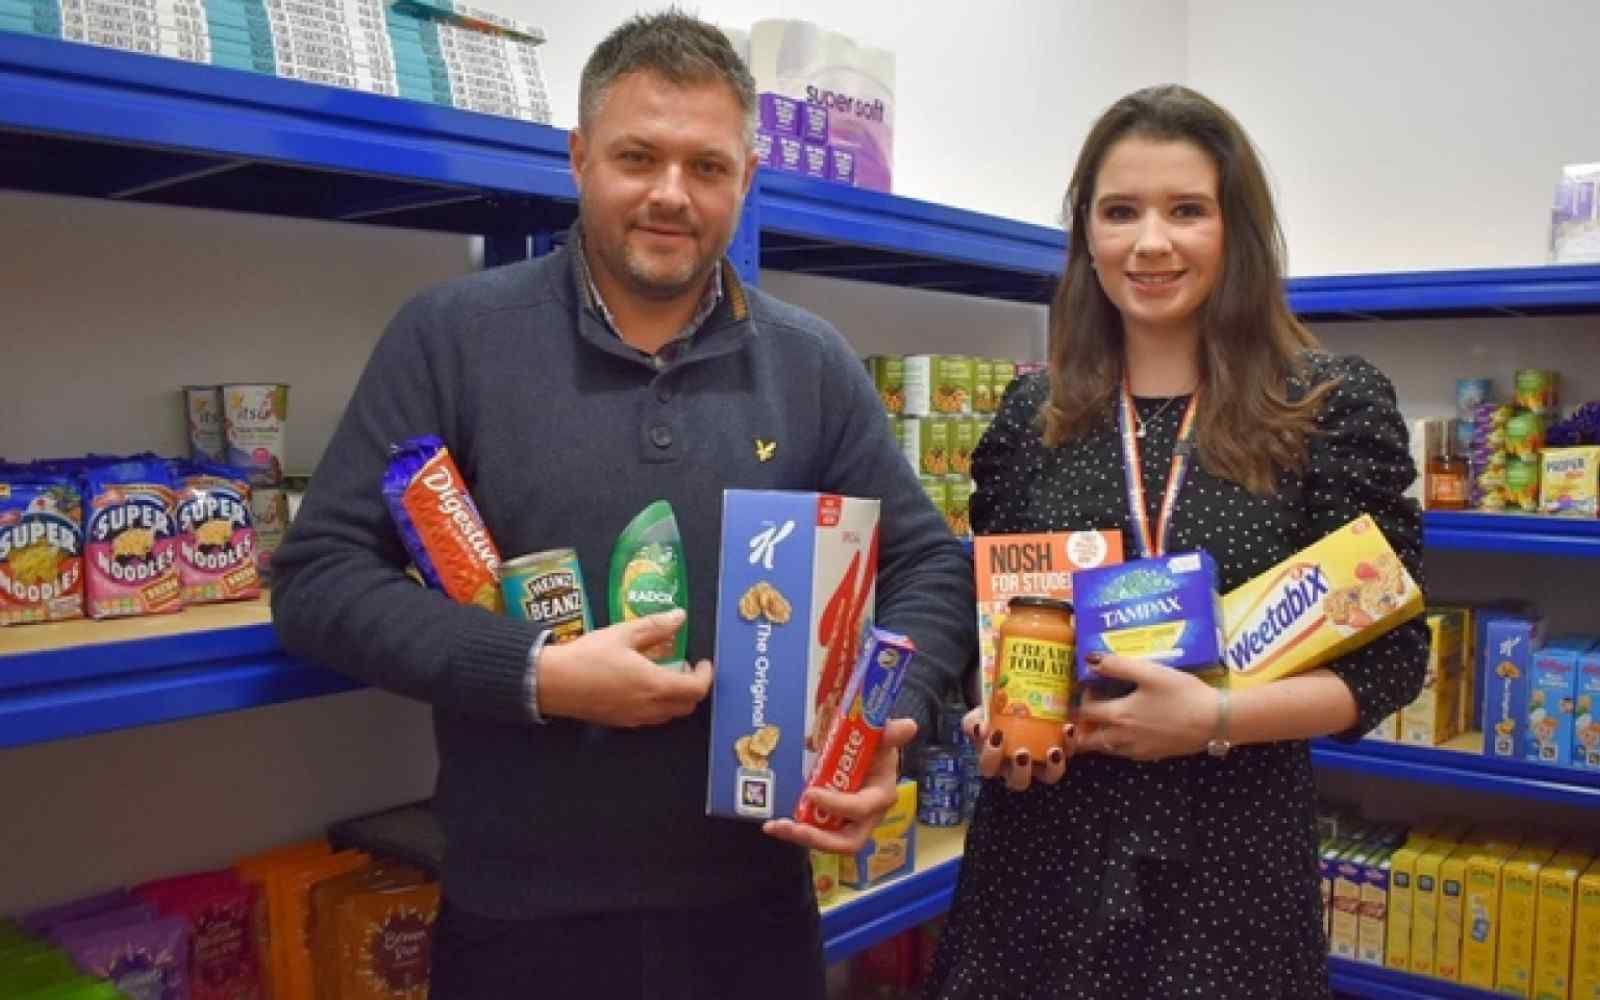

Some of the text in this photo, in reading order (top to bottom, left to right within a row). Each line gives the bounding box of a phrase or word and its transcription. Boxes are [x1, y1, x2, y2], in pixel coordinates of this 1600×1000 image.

[806, 85, 884, 122] super soft
[98, 504, 171, 541] SUPER
[180, 493, 247, 530] SUPER
[98, 542, 175, 583] NOODLES
[180, 534, 251, 569] NOODLES
[990, 541, 1053, 575] NOSH
[992, 570, 1072, 594] FOR STUDE
[528, 592, 581, 621] BEANZ
[1099, 594, 1184, 629] TAMPAX
[1228, 564, 1329, 671] Weetabix
[750, 624, 772, 728] The Original
